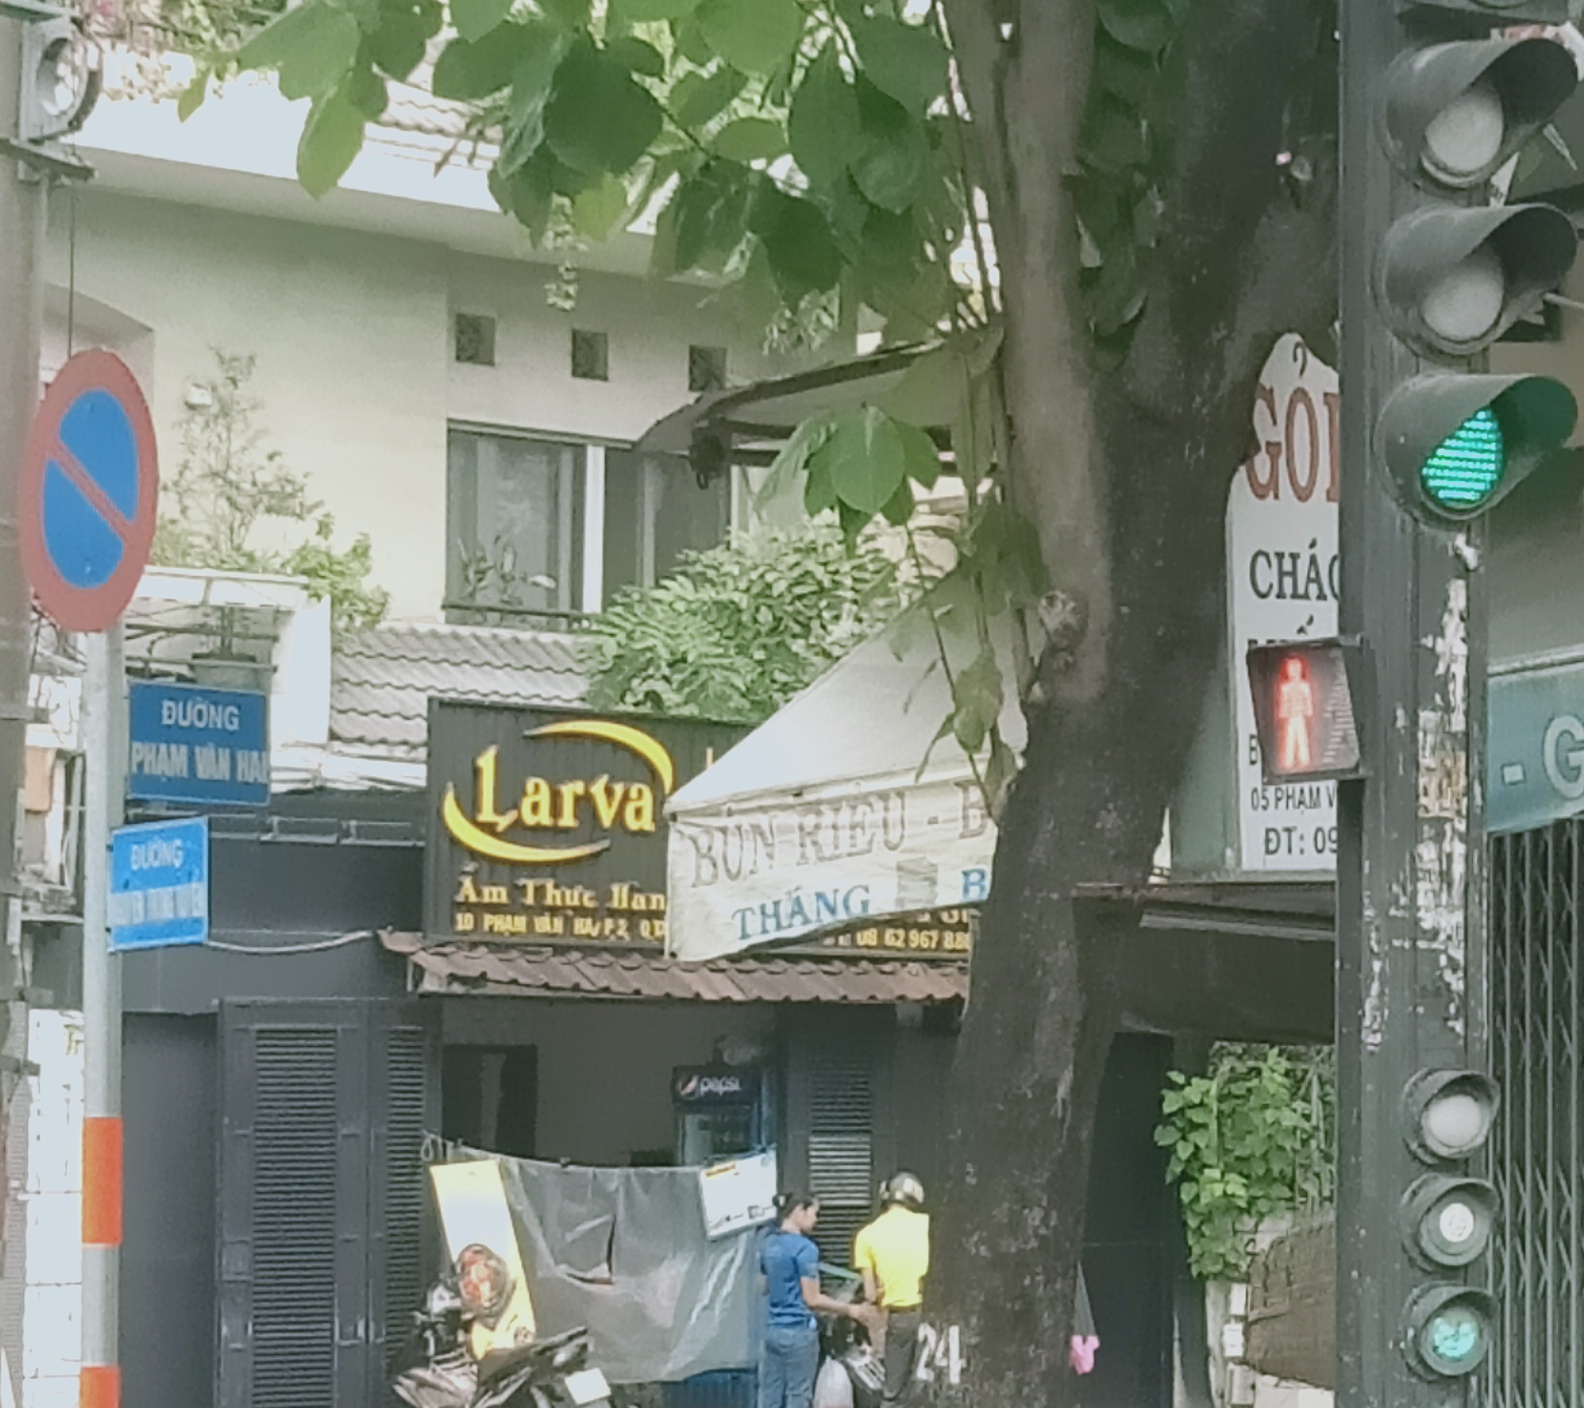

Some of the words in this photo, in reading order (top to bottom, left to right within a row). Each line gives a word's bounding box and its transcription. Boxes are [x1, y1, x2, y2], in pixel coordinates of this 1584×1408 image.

[476, 744, 656, 833] Larva
[1251, 787, 1270, 811] 05
[917, 1322, 967, 1383] 24
